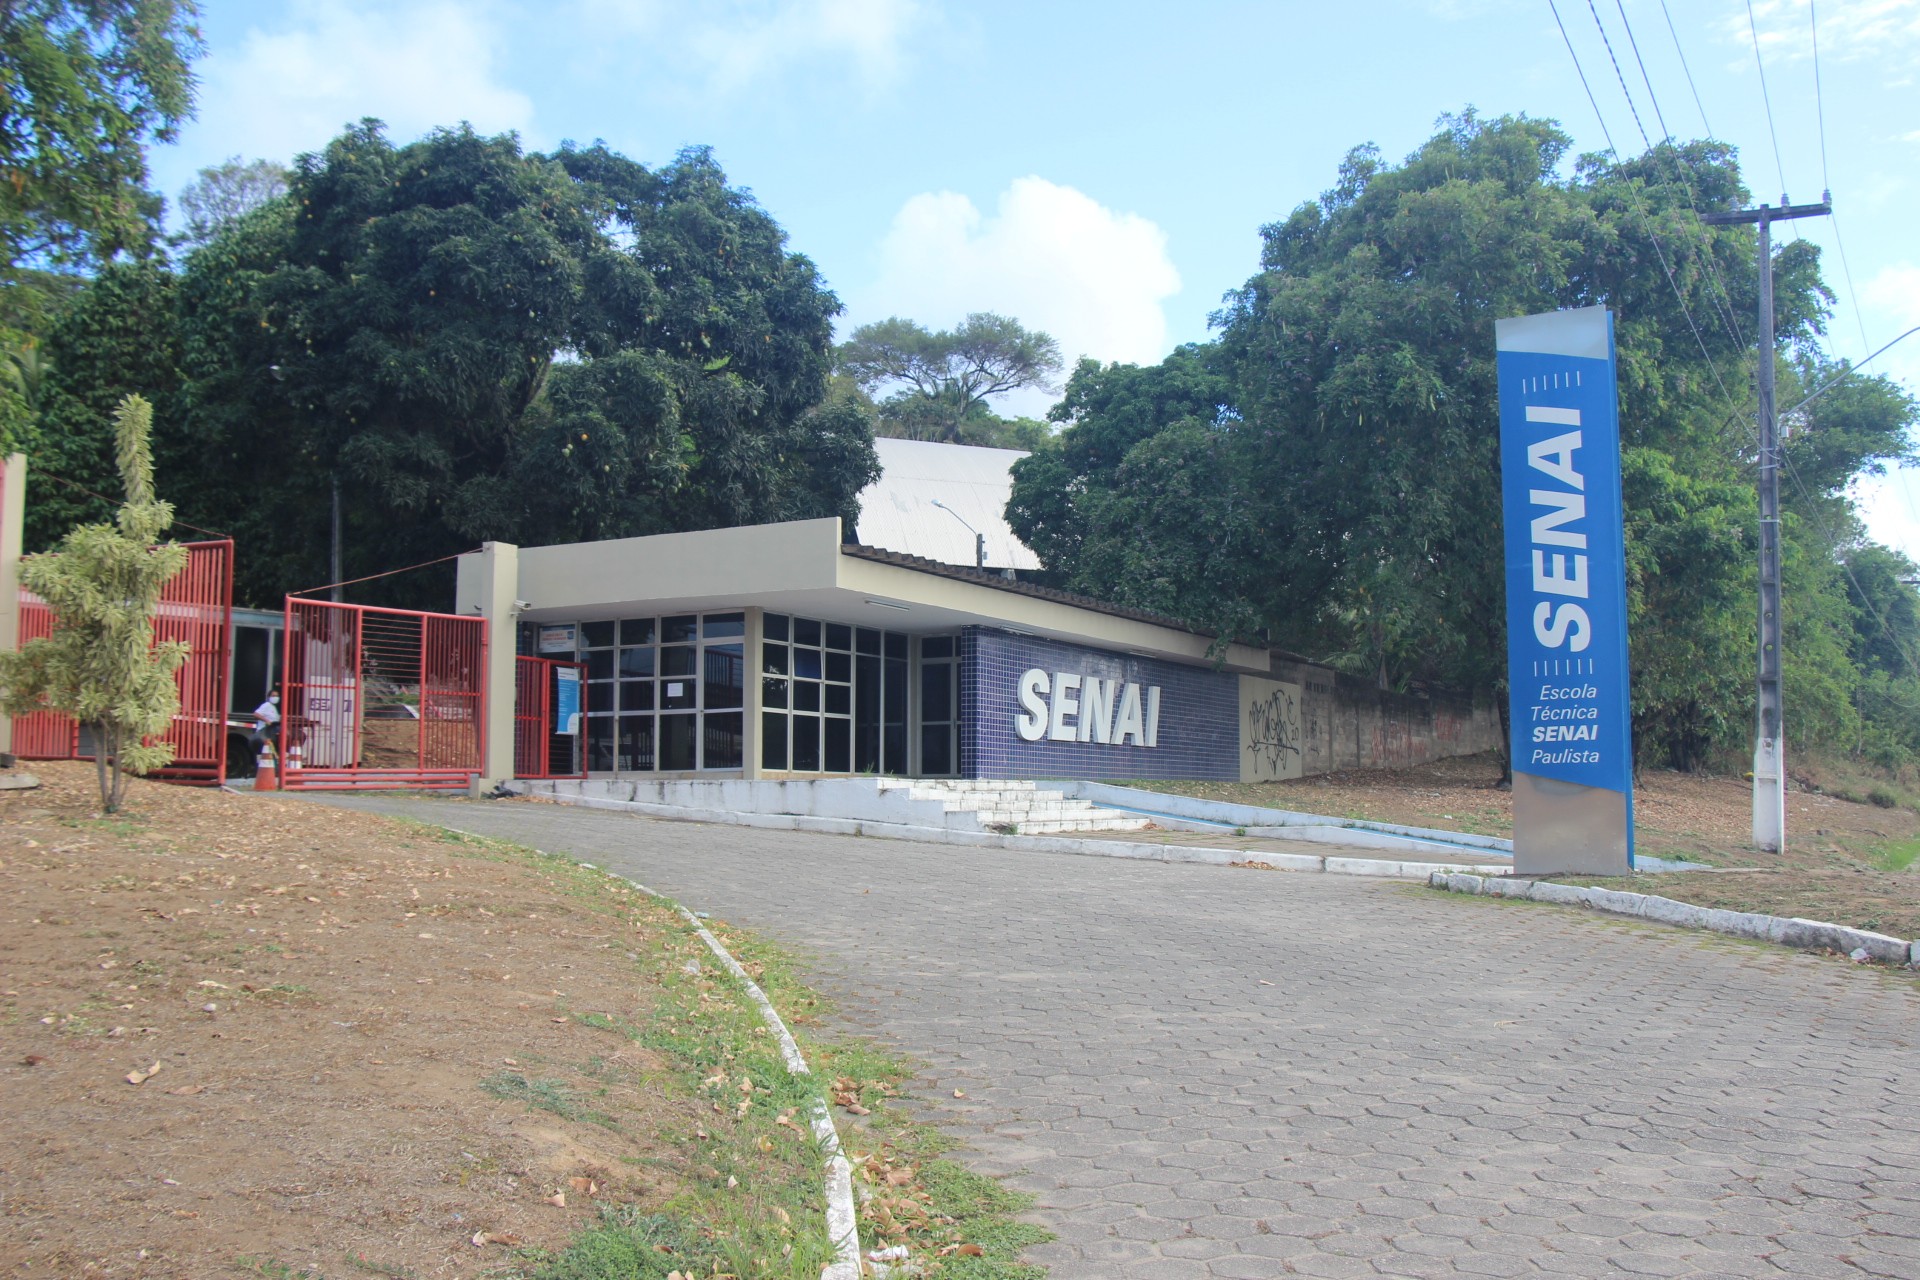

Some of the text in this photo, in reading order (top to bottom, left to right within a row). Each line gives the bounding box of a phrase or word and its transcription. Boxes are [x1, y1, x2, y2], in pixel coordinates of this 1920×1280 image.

[1525, 405, 1591, 653] SENAI
[1540, 683, 1597, 700] Escola
[1014, 668, 1161, 748] SENAI
[1531, 704, 1598, 721] Técnica
[1532, 724, 1599, 742] SENAI
[1531, 748, 1600, 764] Paulista
